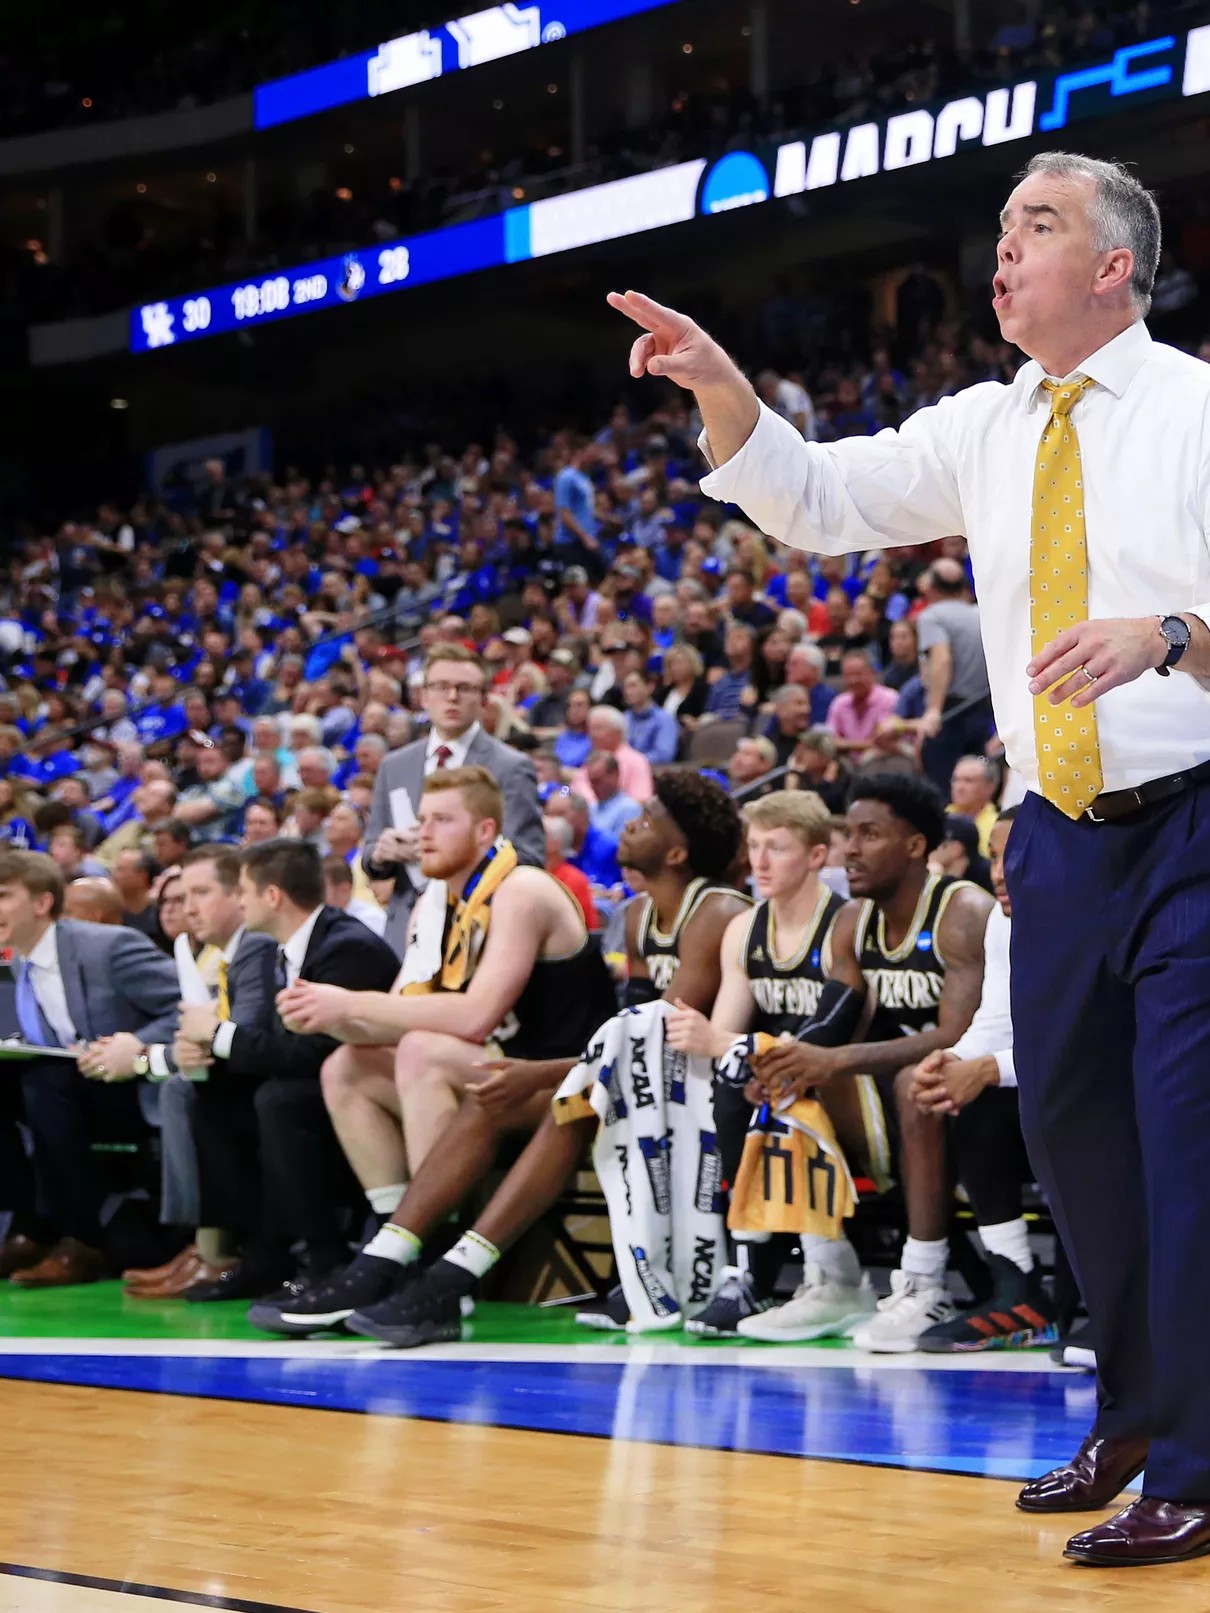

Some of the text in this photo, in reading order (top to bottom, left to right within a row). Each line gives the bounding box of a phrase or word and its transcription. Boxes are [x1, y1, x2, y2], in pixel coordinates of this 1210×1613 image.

[182, 296, 211, 332] 30
[378, 245, 410, 285] 28
[630, 1037, 655, 1109] NCAA
[688, 1236, 717, 1303] NCAA
